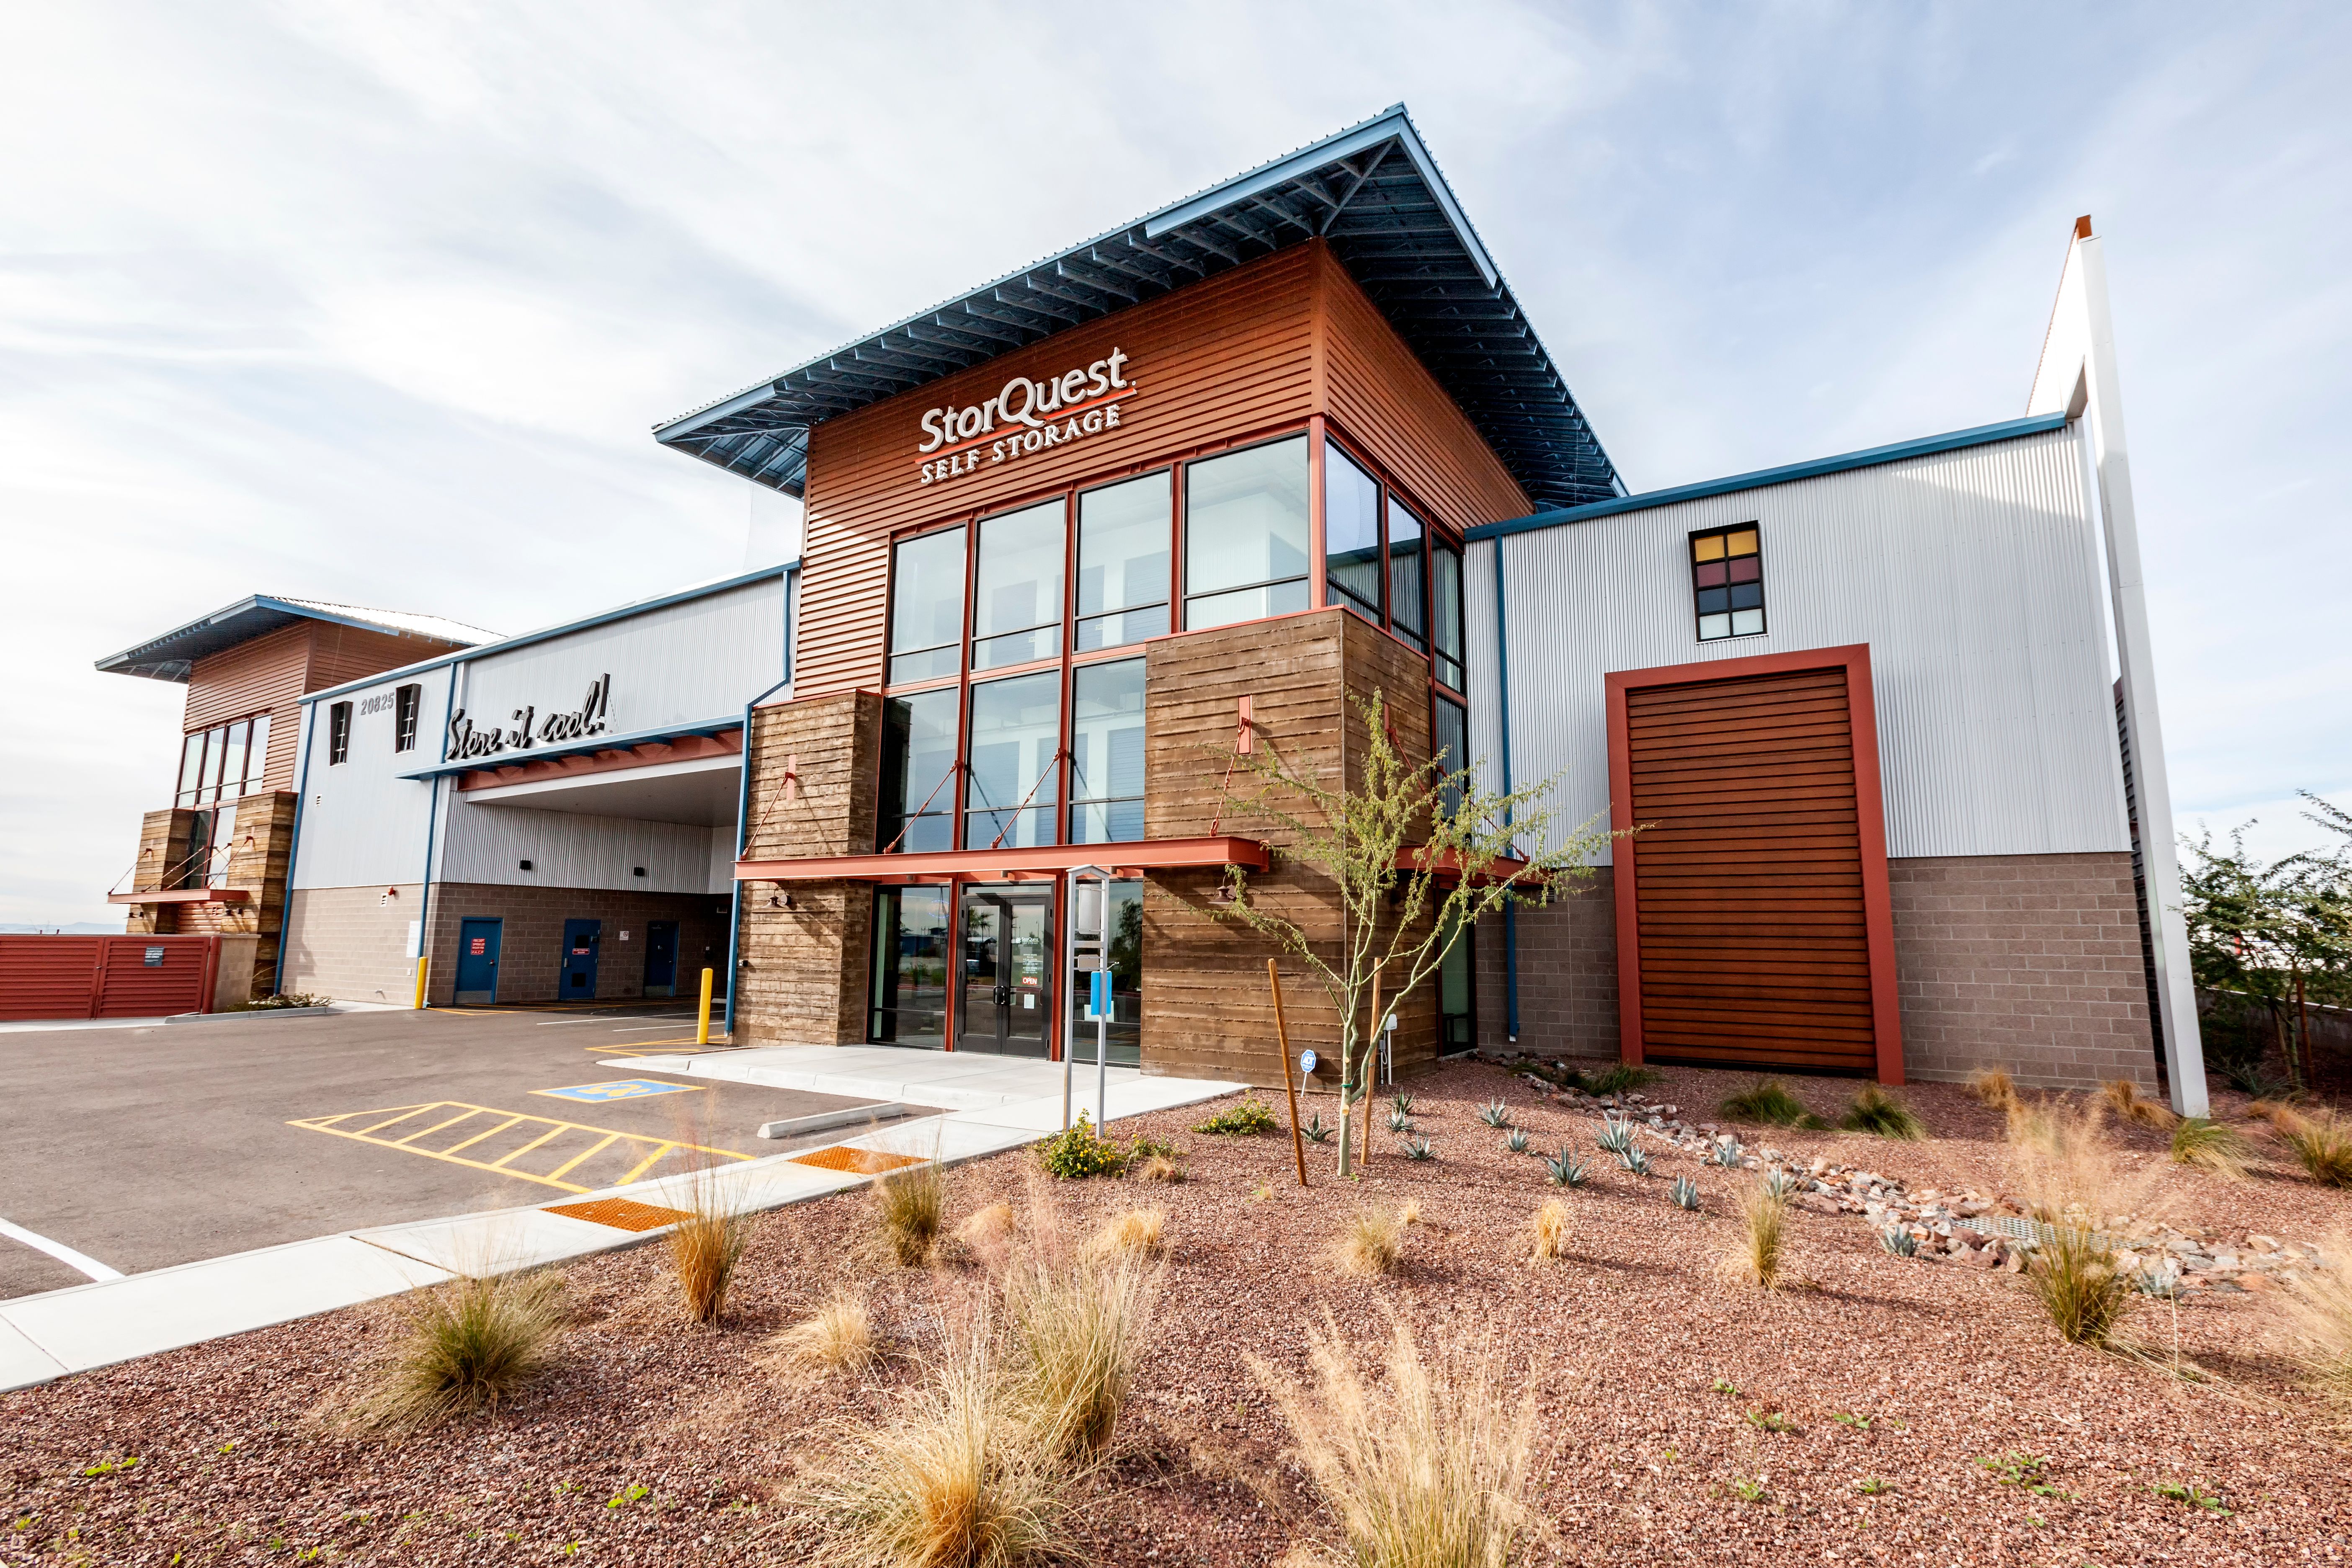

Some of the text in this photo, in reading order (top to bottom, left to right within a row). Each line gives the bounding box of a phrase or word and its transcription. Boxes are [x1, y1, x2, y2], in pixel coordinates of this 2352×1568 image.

[919, 346, 1128, 453] StorQuest
[921, 404, 1120, 485] SELF STORAGE
[361, 692, 395, 716] 20825
[445, 673, 611, 760] Store it cool!
[1302, 1055, 1315, 1066] ADT
